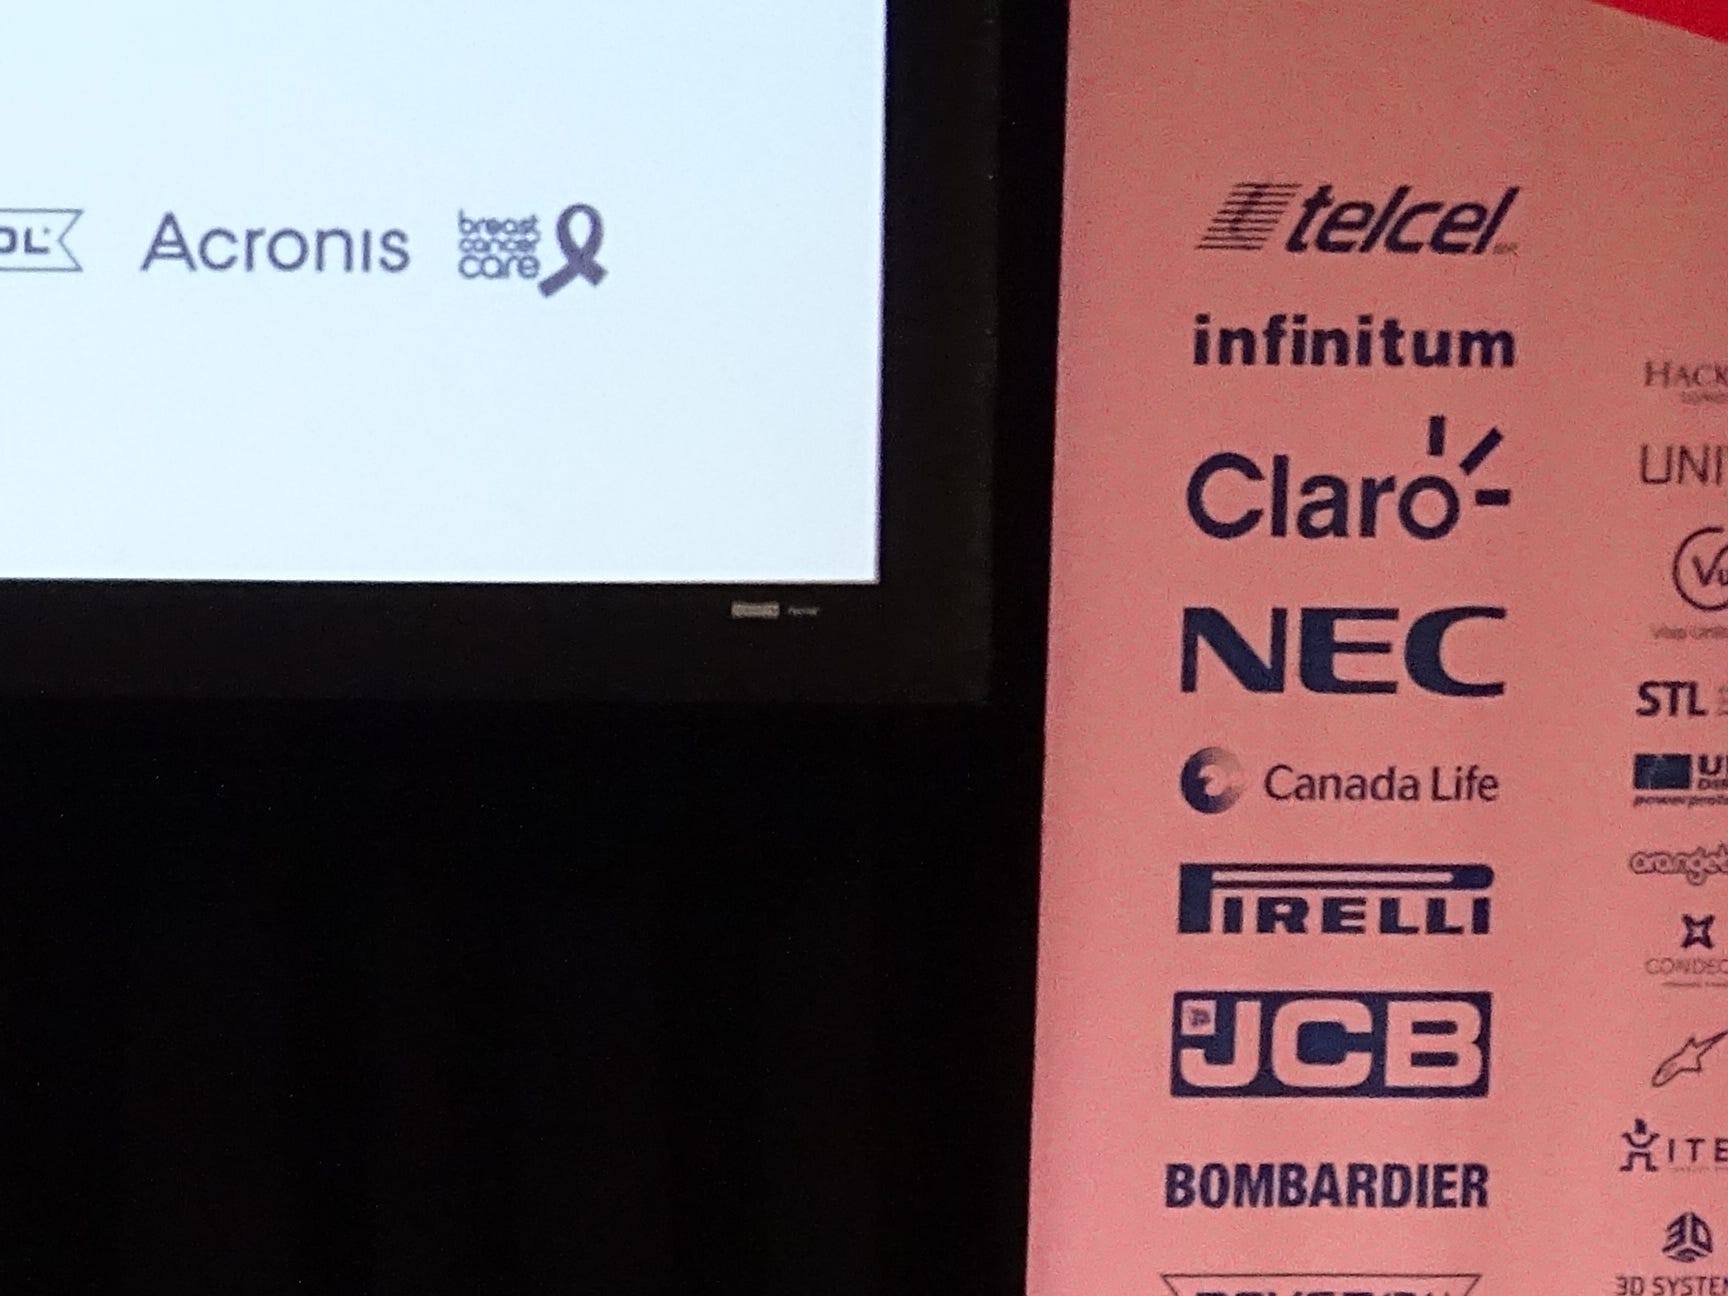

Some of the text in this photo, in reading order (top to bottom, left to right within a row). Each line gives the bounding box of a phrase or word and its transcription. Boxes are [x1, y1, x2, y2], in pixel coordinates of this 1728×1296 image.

[141, 211, 411, 273] Acronis
[1286, 183, 1520, 254] telcel
[457, 254, 541, 279] care
[1192, 314, 1516, 368] infinitum
[1640, 443, 1728, 486] UNI
[1186, 452, 1461, 540] Claro
[1180, 605, 1507, 697] NEC
[1636, 680, 1709, 716] STL
[1264, 764, 1500, 802] Canada Life
[1178, 862, 1495, 935] PIRELLI
[1179, 998, 1484, 1089] JCB
[1164, 1162, 1489, 1209] BOMBARDIER
[1616, 1276, 1645, 1296] 3D
